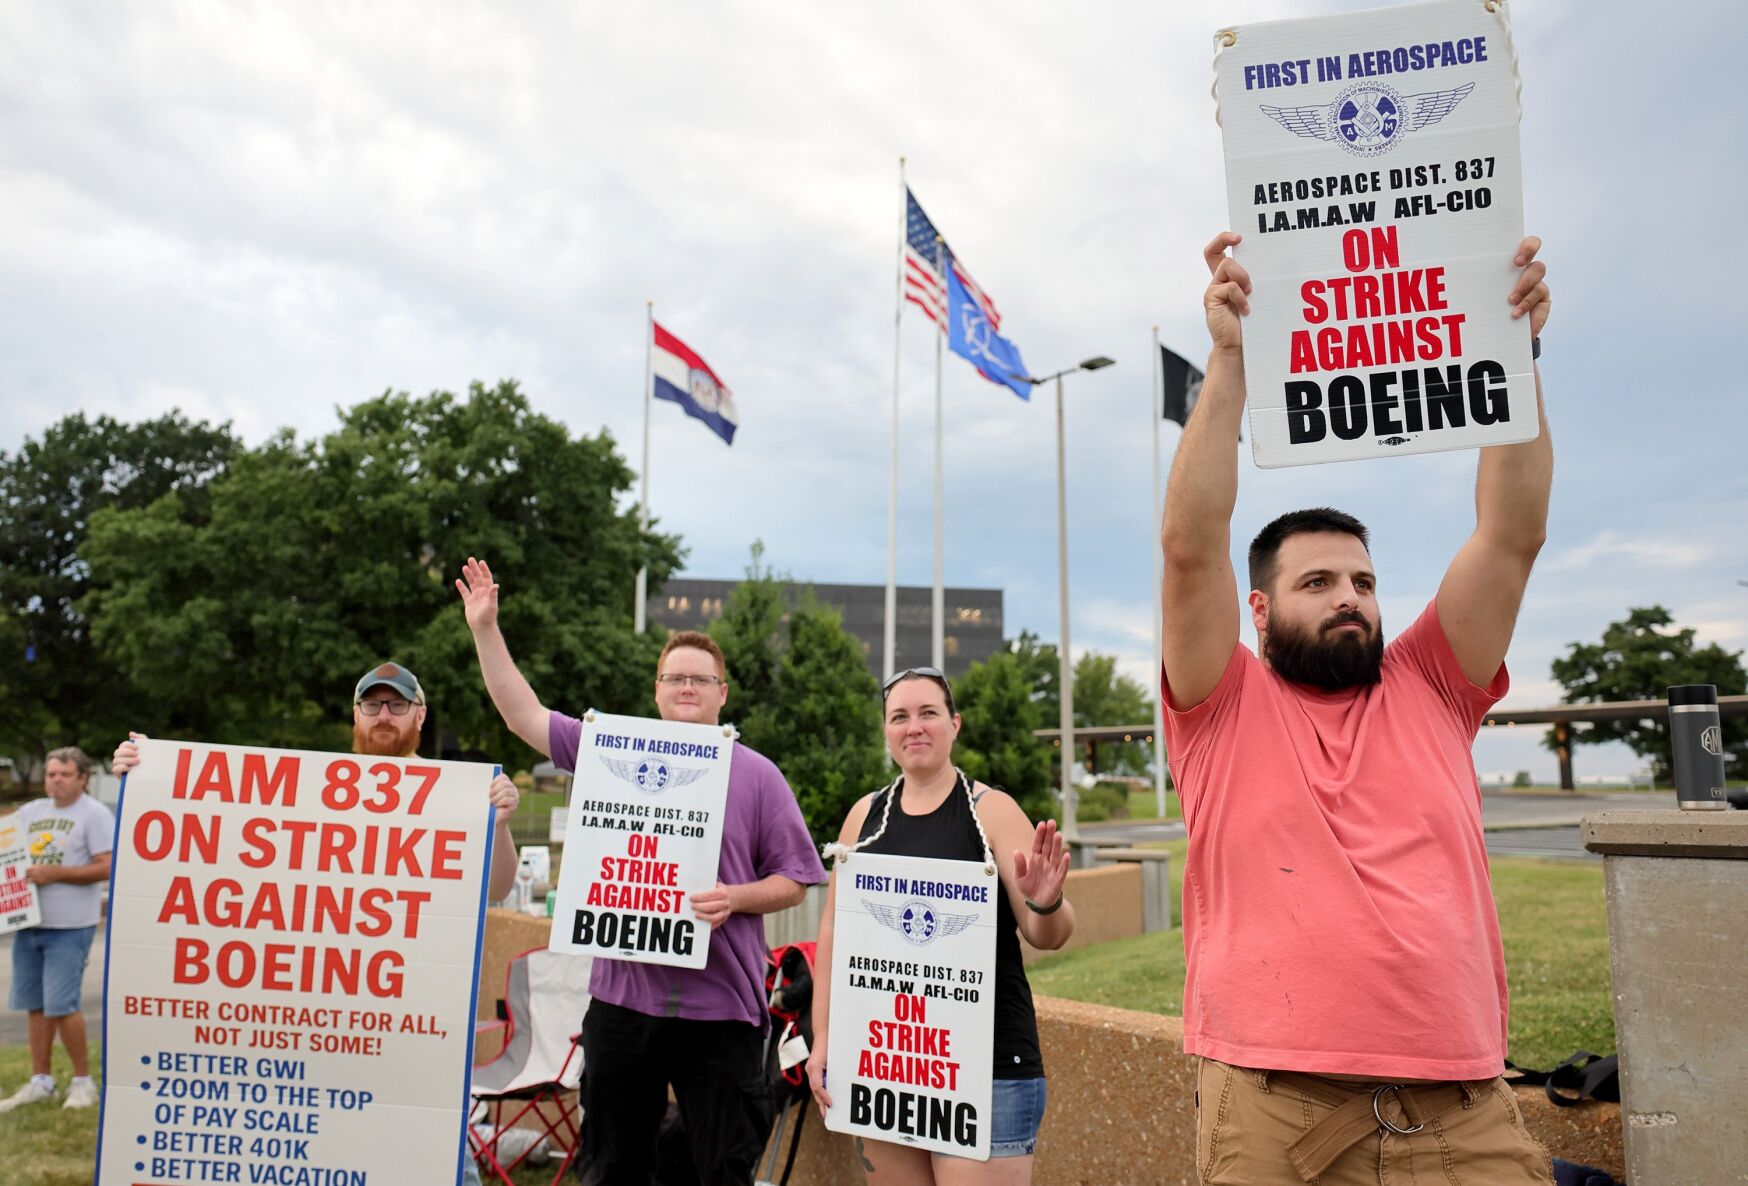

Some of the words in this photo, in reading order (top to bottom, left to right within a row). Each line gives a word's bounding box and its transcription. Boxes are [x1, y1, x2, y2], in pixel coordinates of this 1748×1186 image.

[1244, 60, 1310, 90] FIRST
[1317, 56, 1341, 82] IN
[1348, 37, 1487, 79] AEROSPACE
[1333, 93, 1351, 124] ASSOCIATION
[1253, 171, 1381, 205] AEROSPACE
[1390, 164, 1446, 190] DIST.
[1455, 157, 1495, 181] 837
[1258, 201, 1375, 233] I.A.M.A.W
[1394, 187, 1491, 219] AFL-CIO
[1343, 226, 1400, 272] ON
[1301, 267, 1448, 324] STRIKE
[1290, 314, 1466, 374] AGAINST
[1284, 360, 1510, 444] BOEING
[595, 734, 630, 749] FIRST
[633, 738, 645, 751] IN
[649, 739, 719, 759] AEROSPACE
[172, 749, 301, 806] IAM
[321, 760, 441, 815] 837
[582, 816, 644, 832] I.A.M.A.W
[653, 823, 704, 838] AFL-CIO
[583, 800, 650, 817] AEROSPACE
[655, 807, 684, 820] DIST.
[688, 810, 710, 823] 837
[133, 810, 221, 864] ON
[238, 818, 466, 880] STRIKE
[628, 834, 658, 858] ON
[600, 857, 679, 886] STRIKE
[587, 883, 685, 914] AGAINST
[856, 874, 891, 893] FIRST
[895, 878, 908, 894] IN
[911, 880, 988, 903] AEROSPACE
[157, 876, 431, 938] AGAINST
[572, 909, 694, 956] BOEING
[173, 938, 405, 998] BOEING
[849, 956, 918, 976] AEROSPACE
[923, 964, 955, 981] DIST.
[960, 969, 983, 984] 837
[849, 974, 914, 995] I.A.M.A.W
[923, 983, 979, 1003] AFL-CIO
[124, 997, 209, 1020] BETTER
[218, 1003, 342, 1029] CONTRACT
[349, 1011, 392, 1031] FOR
[399, 1015, 447, 1039] ALL,
[895, 994, 926, 1024] ON
[195, 1026, 240, 1047] NOT
[249, 1029, 303, 1051] JUST
[310, 1032, 382, 1056] SOME!
[869, 1020, 950, 1057] STRIKE
[158, 1053, 247, 1076] BETTER
[257, 1057, 305, 1080] GWI
[858, 1049, 960, 1091] AGAINST
[156, 1078, 228, 1101] ZOOM
[240, 1083, 268, 1103] TO
[276, 1084, 319, 1106] THE
[327, 1088, 372, 1110] TOP
[155, 1103, 185, 1125] OF
[193, 1106, 237, 1129] PAY
[244, 1110, 319, 1134] SCALE
[850, 1083, 978, 1148] BOEING
[154, 1131, 242, 1156] BETTER
[249, 1135, 310, 1159] 401K
[151, 1158, 241, 1182] BETTER
[249, 1164, 366, 1186] VACATION
